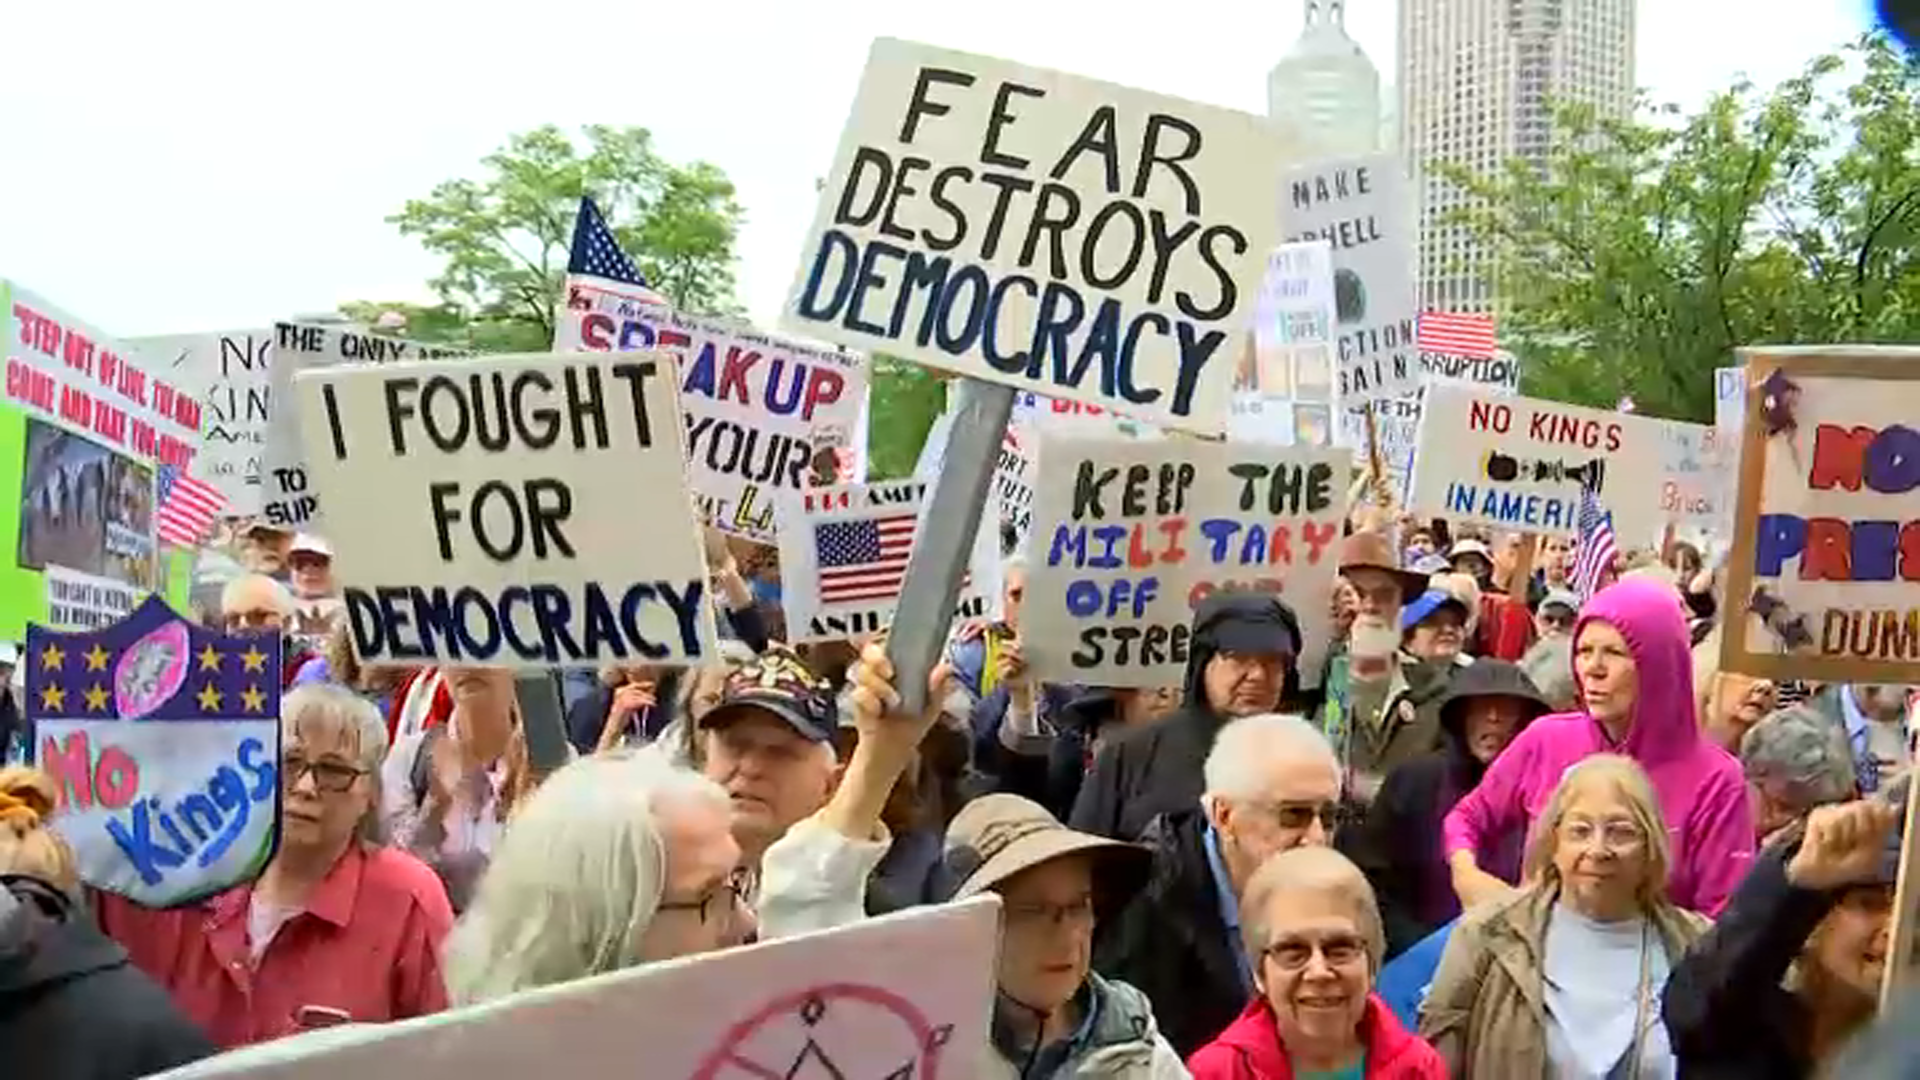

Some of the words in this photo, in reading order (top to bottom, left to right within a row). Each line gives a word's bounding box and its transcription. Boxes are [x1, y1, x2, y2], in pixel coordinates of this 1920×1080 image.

[899, 66, 1202, 217] FEAR
[1292, 166, 1371, 210] MAKE
[834, 145, 1248, 322] DESTROYS
[276, 323, 325, 353] THE
[340, 333, 405, 363] ONLY
[798, 229, 1226, 417] DEMOCRACY
[1338, 318, 1412, 362] CTION
[764, 357, 845, 421] UP
[1420, 352, 1520, 389] RRUPTION
[6, 360, 55, 415] COME
[61, 384, 92, 429] AND
[95, 401, 126, 444] TAKE
[323, 384, 346, 460] I
[384, 363, 656, 456] FOUGHT
[1470, 400, 1512, 434] NO
[1530, 411, 1623, 452] KINGS
[685, 413, 812, 489] YOUR
[273, 468, 307, 493] TO
[867, 484, 928, 505] AME
[1072, 459, 1196, 521] KEEP
[1228, 461, 1334, 516] THE
[1447, 483, 1476, 514] IN
[1481, 487, 1577, 530] AMERI
[265, 493, 320, 525] SUP
[430, 478, 577, 562] FOR
[1048, 518, 1338, 570] MILITARY
[344, 580, 702, 663] DEMOCRACY
[1066, 577, 1160, 619] OFF
[1071, 623, 1190, 669] STRE
[1820, 608, 1920, 660] DUM
[105, 738, 276, 887] Kings
